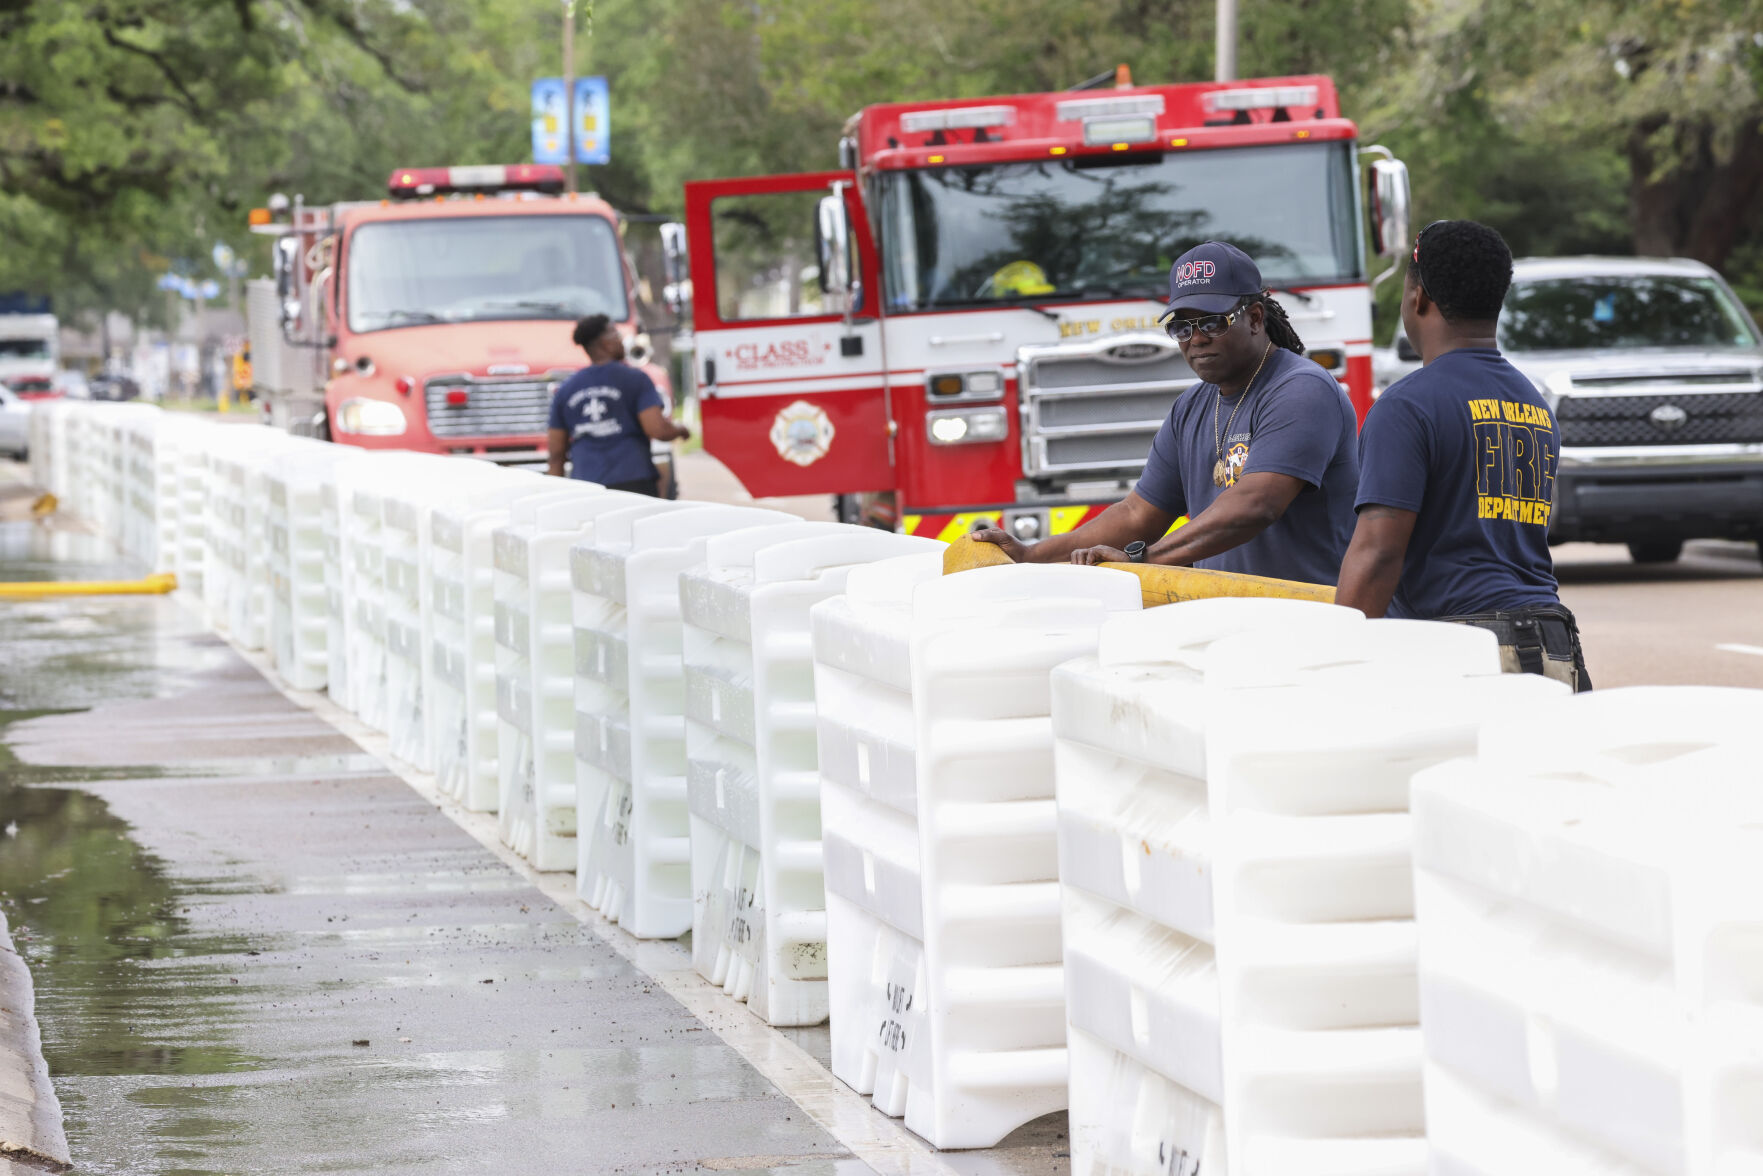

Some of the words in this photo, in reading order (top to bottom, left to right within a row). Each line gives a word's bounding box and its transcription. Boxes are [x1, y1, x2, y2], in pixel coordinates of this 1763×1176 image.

[1175, 260, 1216, 283] NOFD
[1177, 278, 1211, 289] OPERATOR
[1060, 319, 1101, 338] NEW
[1111, 311, 1176, 332] ORLE
[735, 339, 809, 361] CLASS
[1467, 399, 1500, 420] NEW
[1501, 400, 1552, 429] ORLEANS
[1473, 421, 1555, 505] FIRE
